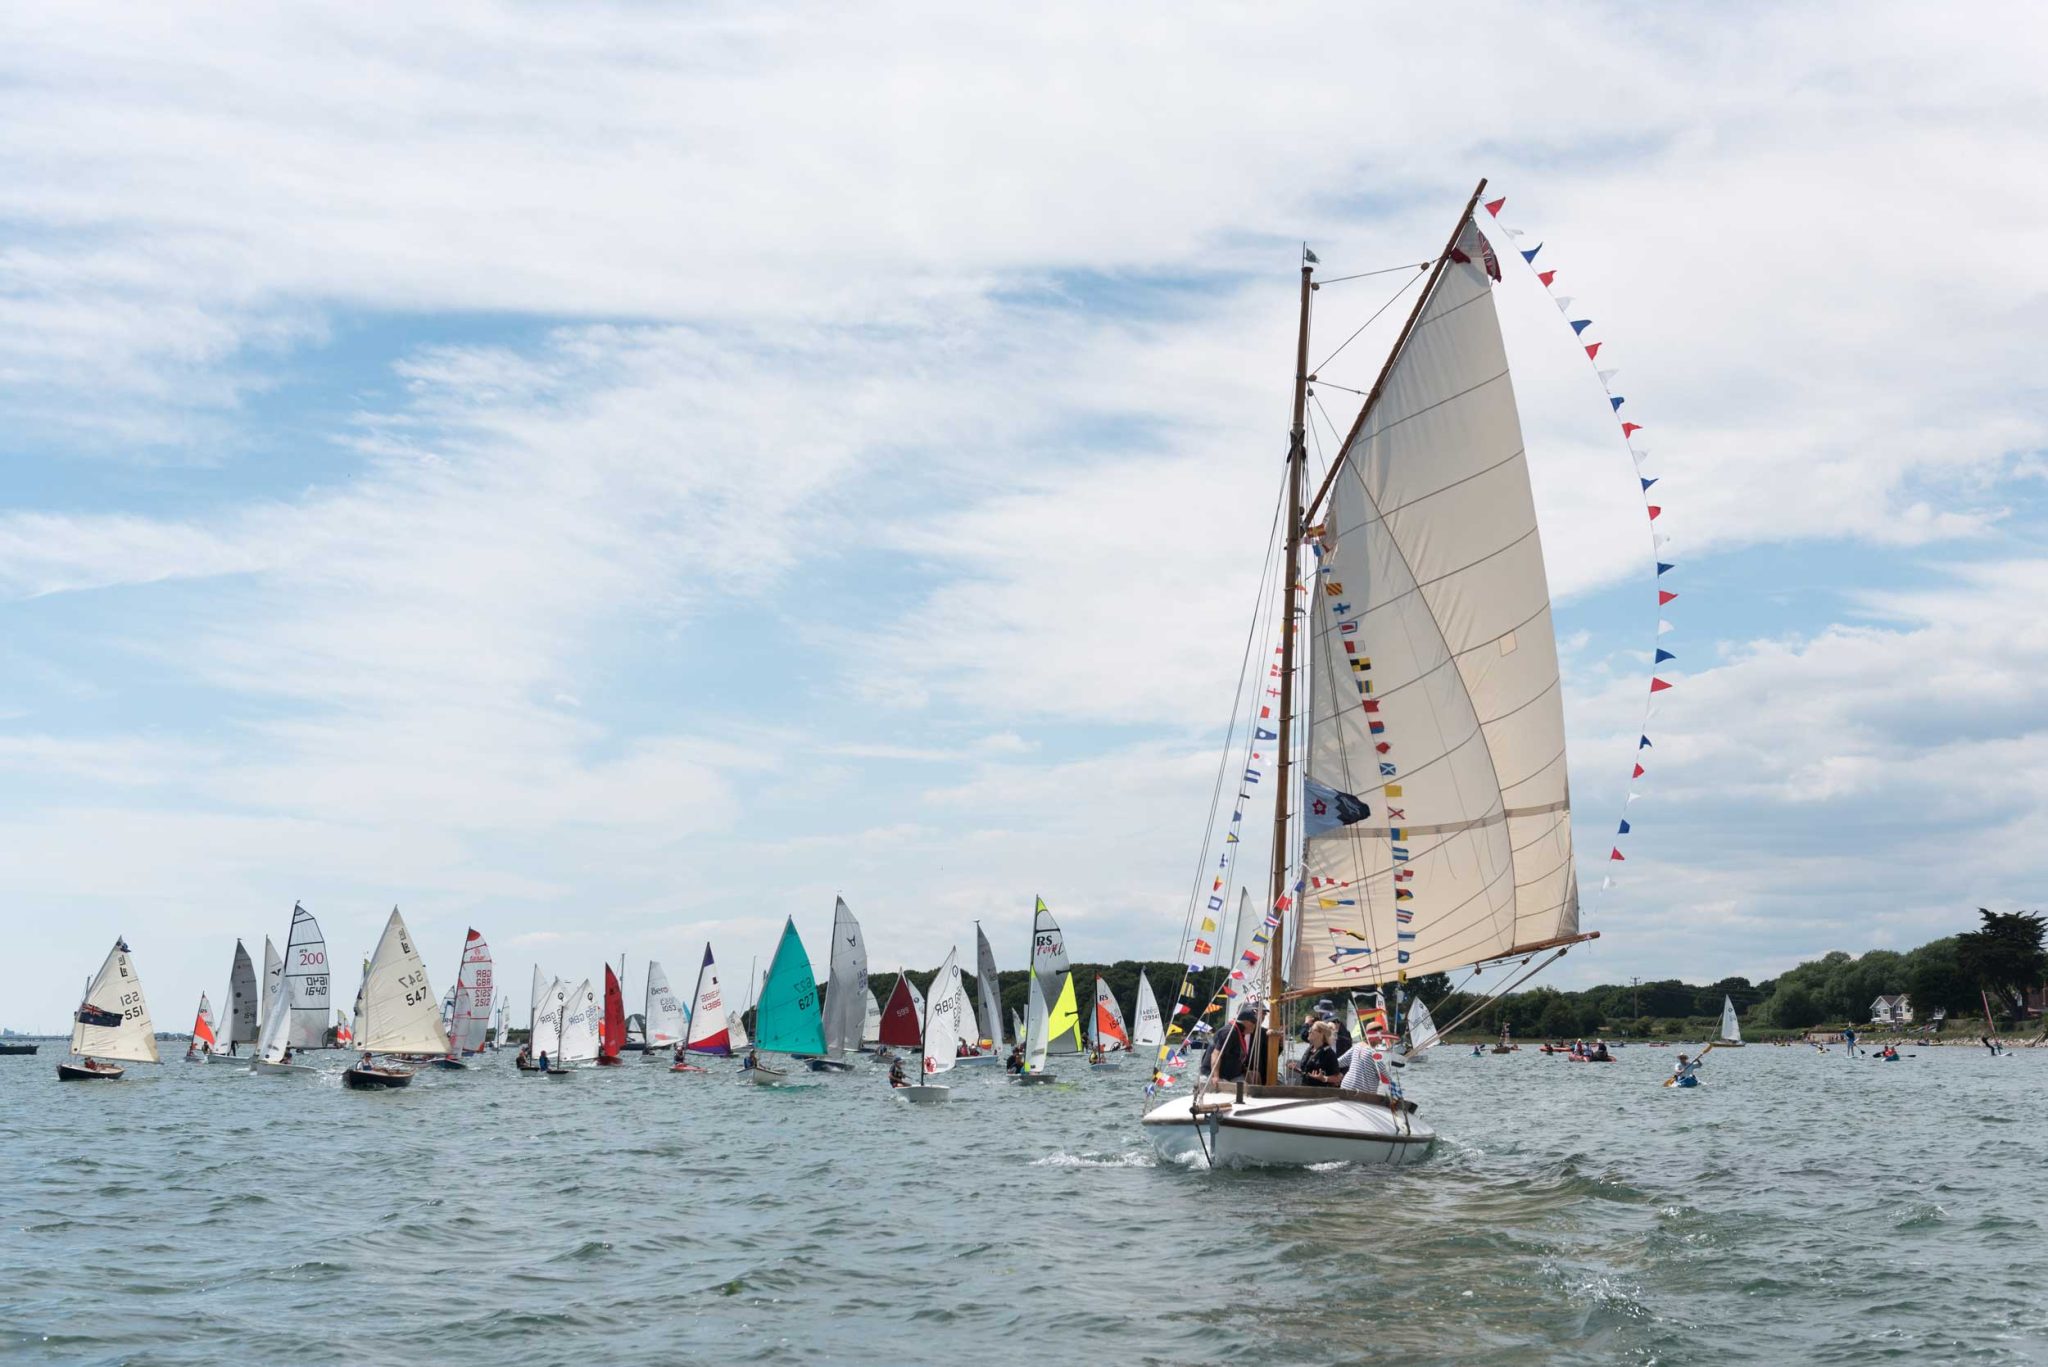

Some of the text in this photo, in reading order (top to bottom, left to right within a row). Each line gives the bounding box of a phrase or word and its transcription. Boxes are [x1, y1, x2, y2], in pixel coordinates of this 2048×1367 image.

[1037, 936, 1052, 946] RS
[300, 952, 324, 966] 200
[305, 987, 327, 996] 1640
[406, 986, 426, 1006] 547
[799, 992, 814, 1010] 627
[125, 1005, 144, 1020] 551
